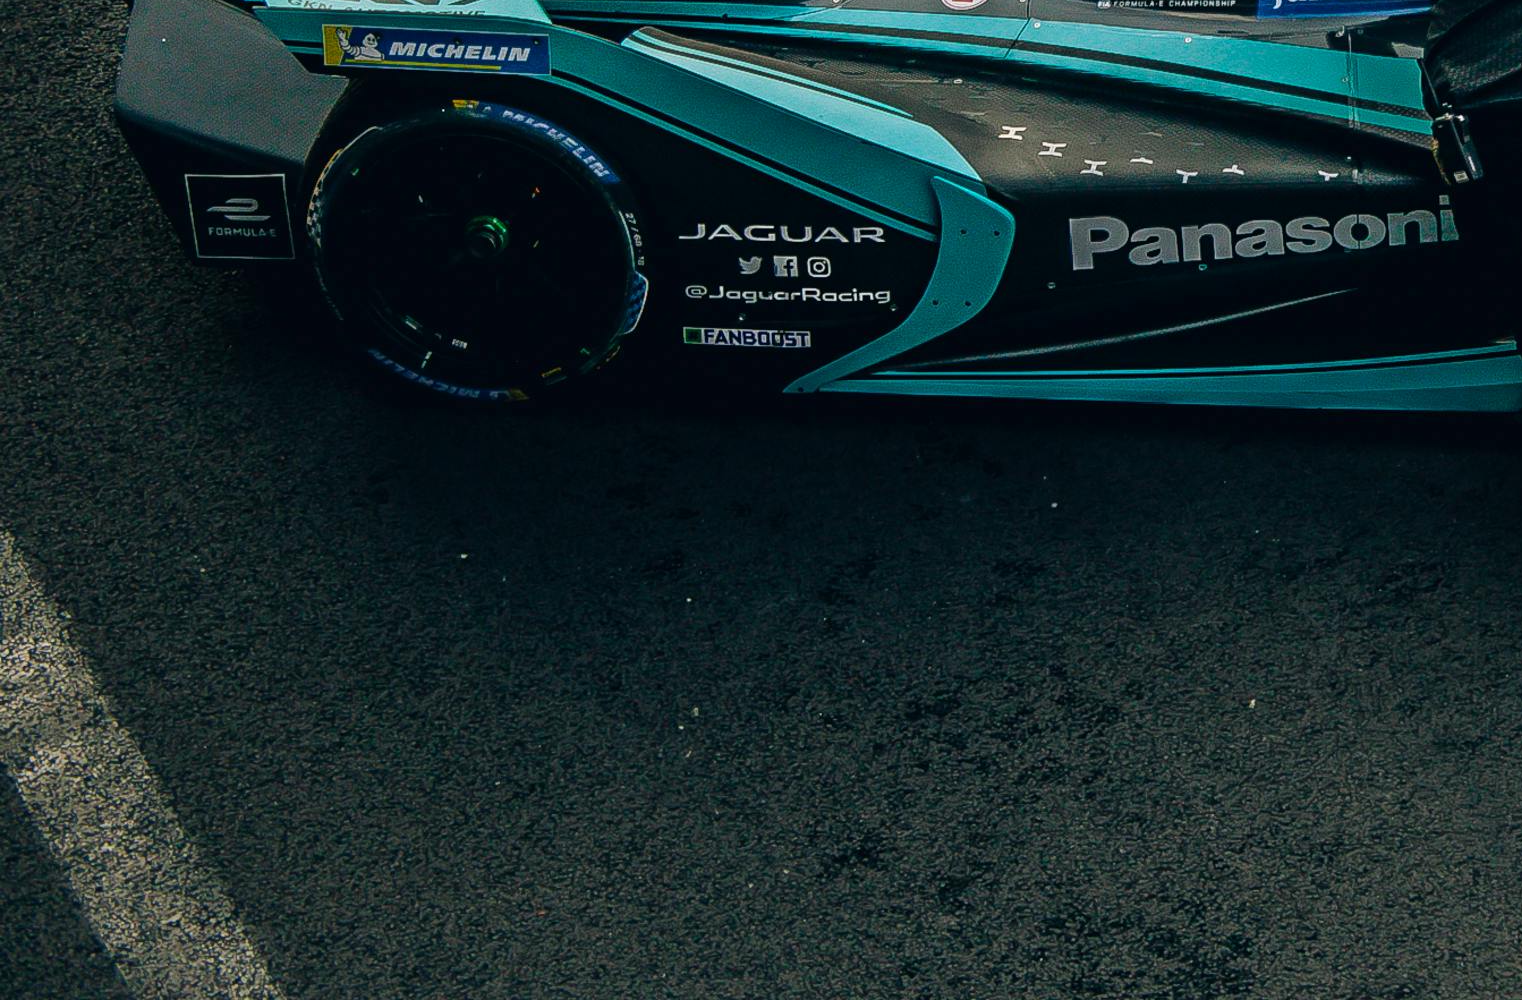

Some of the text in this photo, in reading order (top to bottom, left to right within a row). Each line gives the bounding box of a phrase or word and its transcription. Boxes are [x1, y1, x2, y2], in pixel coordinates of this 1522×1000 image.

[1169, 0, 1236, 8] CHAMPIONSHIP
[388, 41, 531, 62] MICHELIN
[679, 223, 887, 244] JAGUAR
[1069, 195, 1459, 271] Panasoni
[685, 285, 891, 304] @JaguarRacing
[703, 328, 811, 348] FANBOOST
